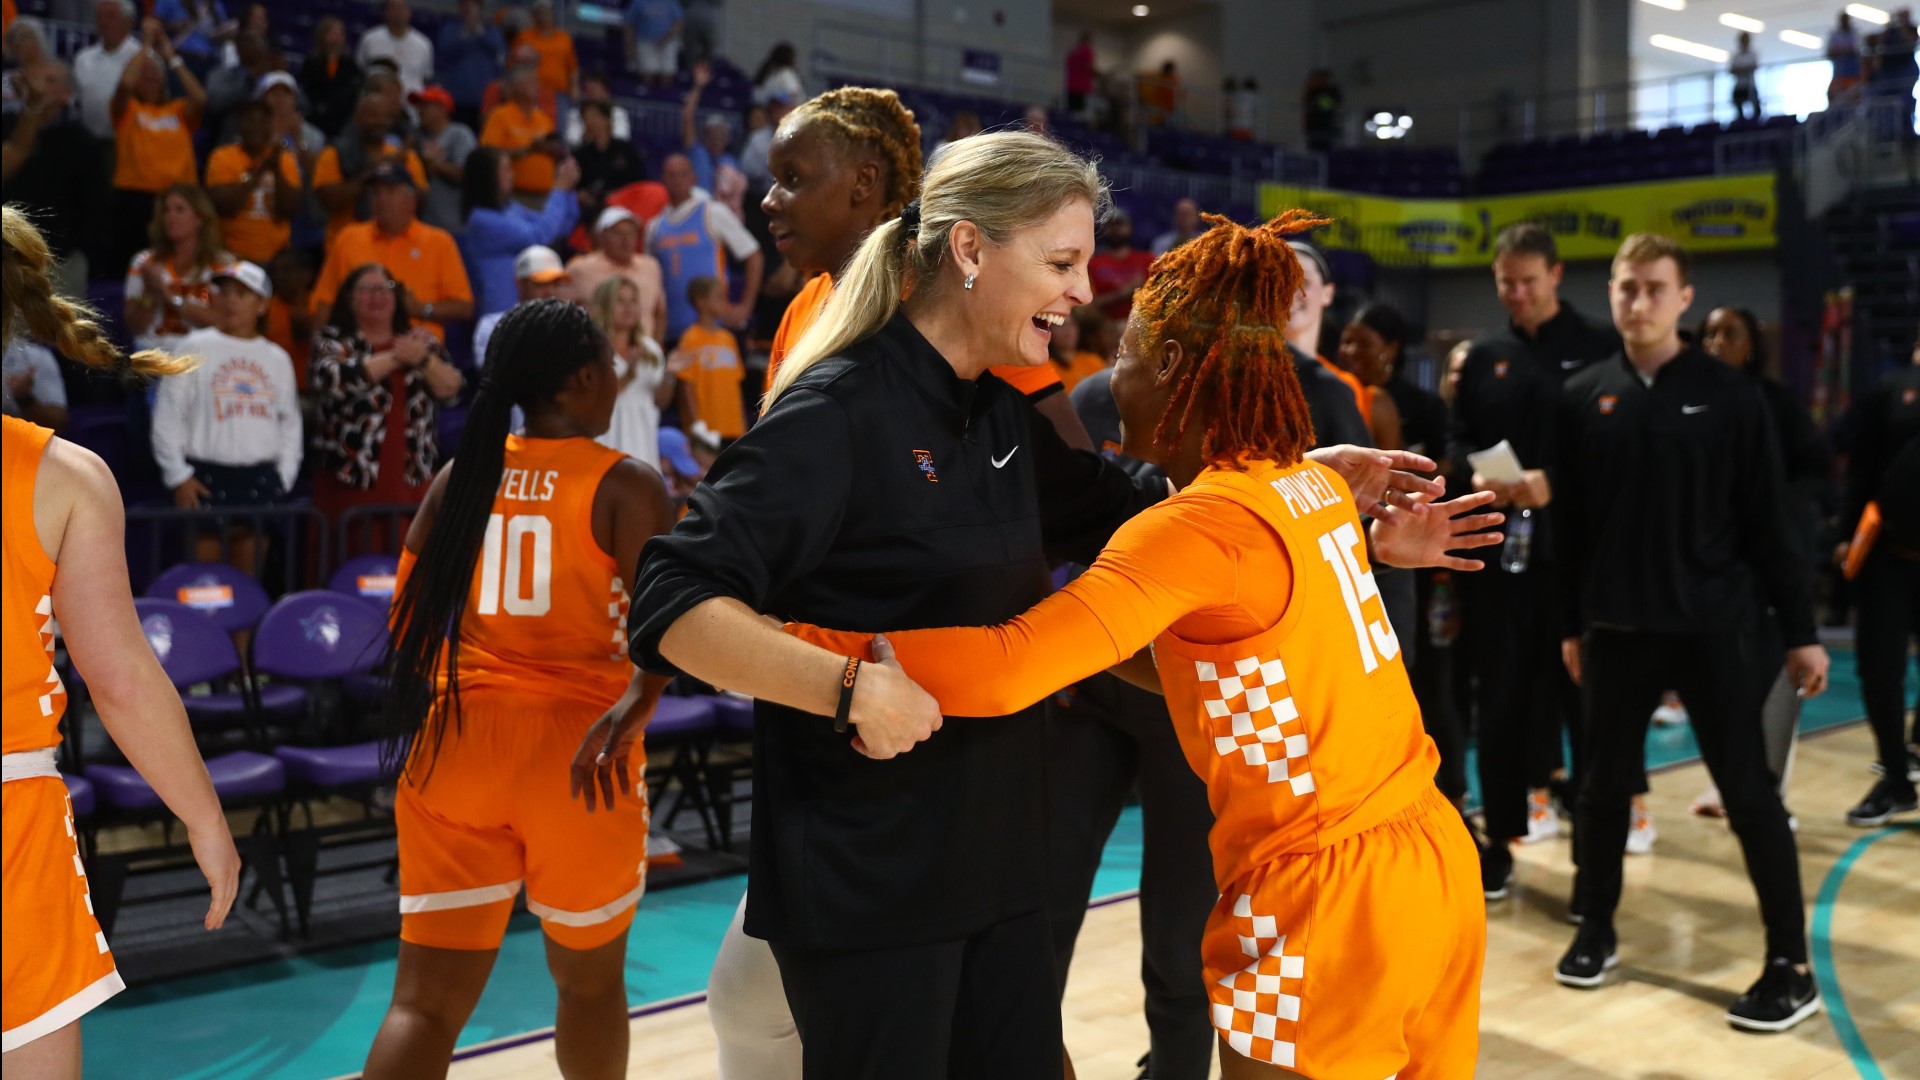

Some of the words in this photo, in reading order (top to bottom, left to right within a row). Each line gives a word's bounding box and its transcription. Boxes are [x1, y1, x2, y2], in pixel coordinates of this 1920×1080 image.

[1269, 466, 1342, 519] POWELL
[478, 513, 552, 617] 10
[1317, 521, 1401, 675] 15
